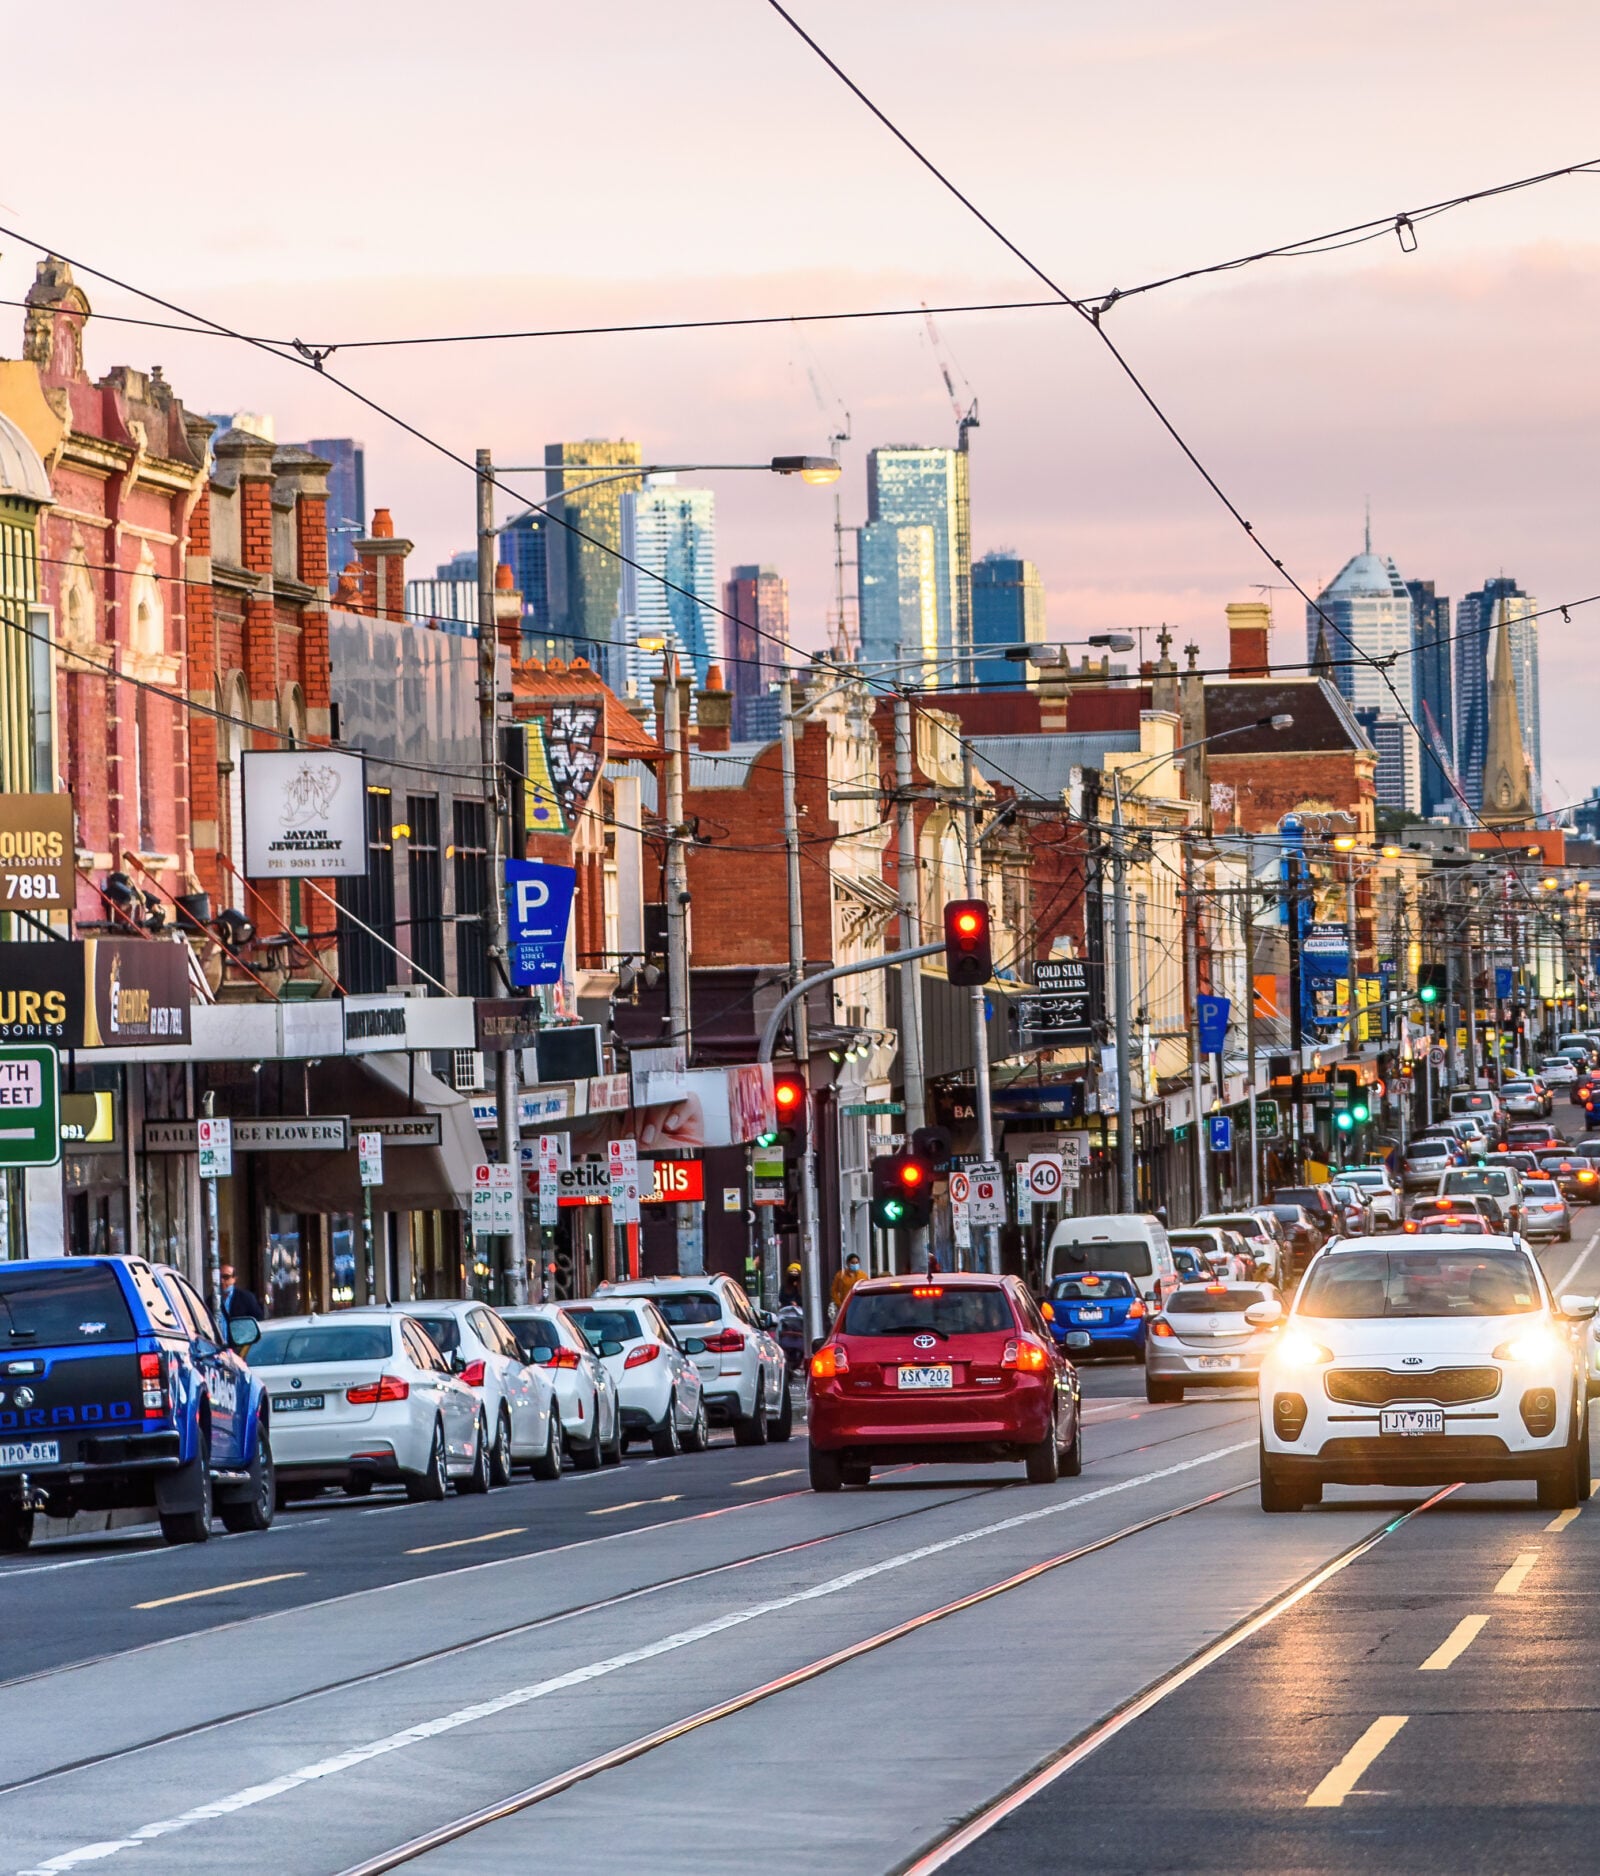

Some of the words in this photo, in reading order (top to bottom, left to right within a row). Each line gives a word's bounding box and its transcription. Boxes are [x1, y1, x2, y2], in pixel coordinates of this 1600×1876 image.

[283, 830, 327, 840] JAYANI
[0, 831, 63, 859] OURS
[268, 840, 342, 852] JEWELLERY
[5, 874, 60, 899] 7891
[516, 879, 550, 923] P
[1037, 965, 1061, 978] GOLD
[1062, 963, 1084, 977] STAR
[1039, 979, 1086, 989] JEWELLERS
[2, 1025, 63, 1036] SORIES
[1215, 1120, 1225, 1132] P
[265, 1126, 342, 1140] FLOWERS
[1034, 1169, 1057, 1186] 40
[474, 1192, 491, 1203] 2P
[901, 1369, 921, 1382] XSK
[930, 1369, 950, 1382] 202
[1417, 1413, 1441, 1428] 9HP
